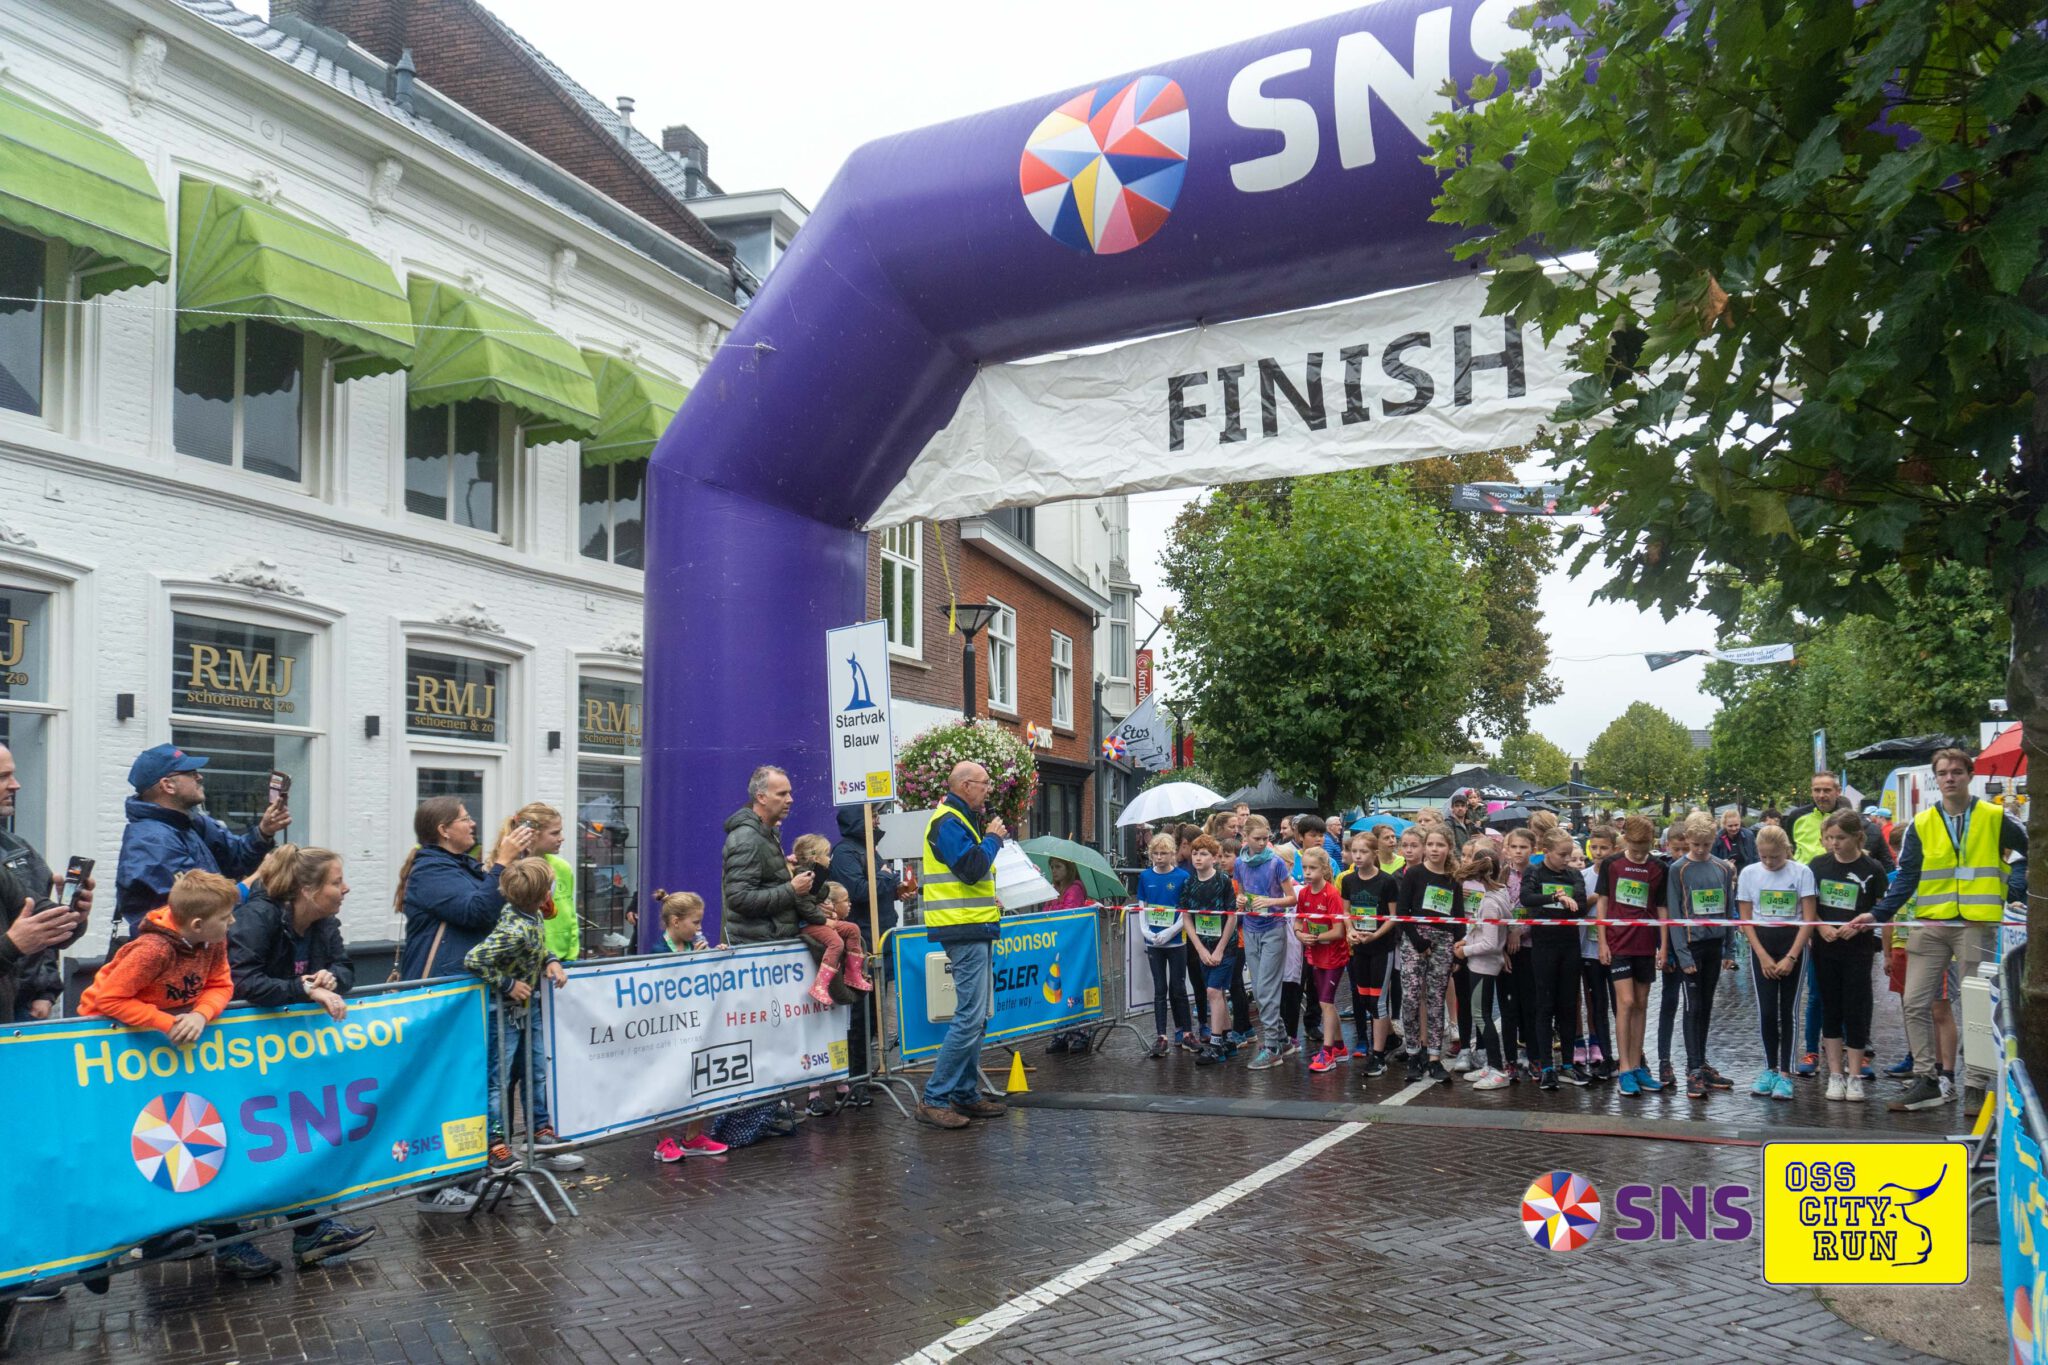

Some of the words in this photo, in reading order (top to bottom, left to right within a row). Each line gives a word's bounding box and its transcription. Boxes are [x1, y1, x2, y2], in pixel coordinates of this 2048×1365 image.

[1227, 0, 1578, 193] SNS
[1166, 314, 1527, 453] FINISH
[5, 672, 29, 686] zo
[188, 643, 296, 698] RMJ
[415, 675, 495, 719] RMJ
[1138, 668, 1149, 706] Kruidv
[187, 688, 259, 709] schoenen
[262, 697, 274, 711] &
[277, 701, 295, 713] zo
[415, 711, 467, 730] schoenen
[470, 719, 479, 731] &
[482, 723, 494, 733] zo
[836, 709, 886, 728] Startvak
[584, 731, 625, 746] schoenen
[844, 734, 880, 748] Blauw
[1122, 724, 1150, 741] Etos
[849, 781, 866, 792] SNS
[1627, 886, 1642, 896] 767
[615, 961, 805, 1009] Horecapartners
[993, 962, 1039, 992] SLER
[589, 1025, 615, 1045] LA
[625, 1010, 701, 1040] COLLINE
[726, 1011, 768, 1027] HEER
[74, 1016, 408, 1088] Hoofdsponsor
[812, 1052, 830, 1066] SNS
[693, 1053, 749, 1091] H32
[240, 1077, 381, 1163] SNS
[411, 1135, 442, 1156] SNS
